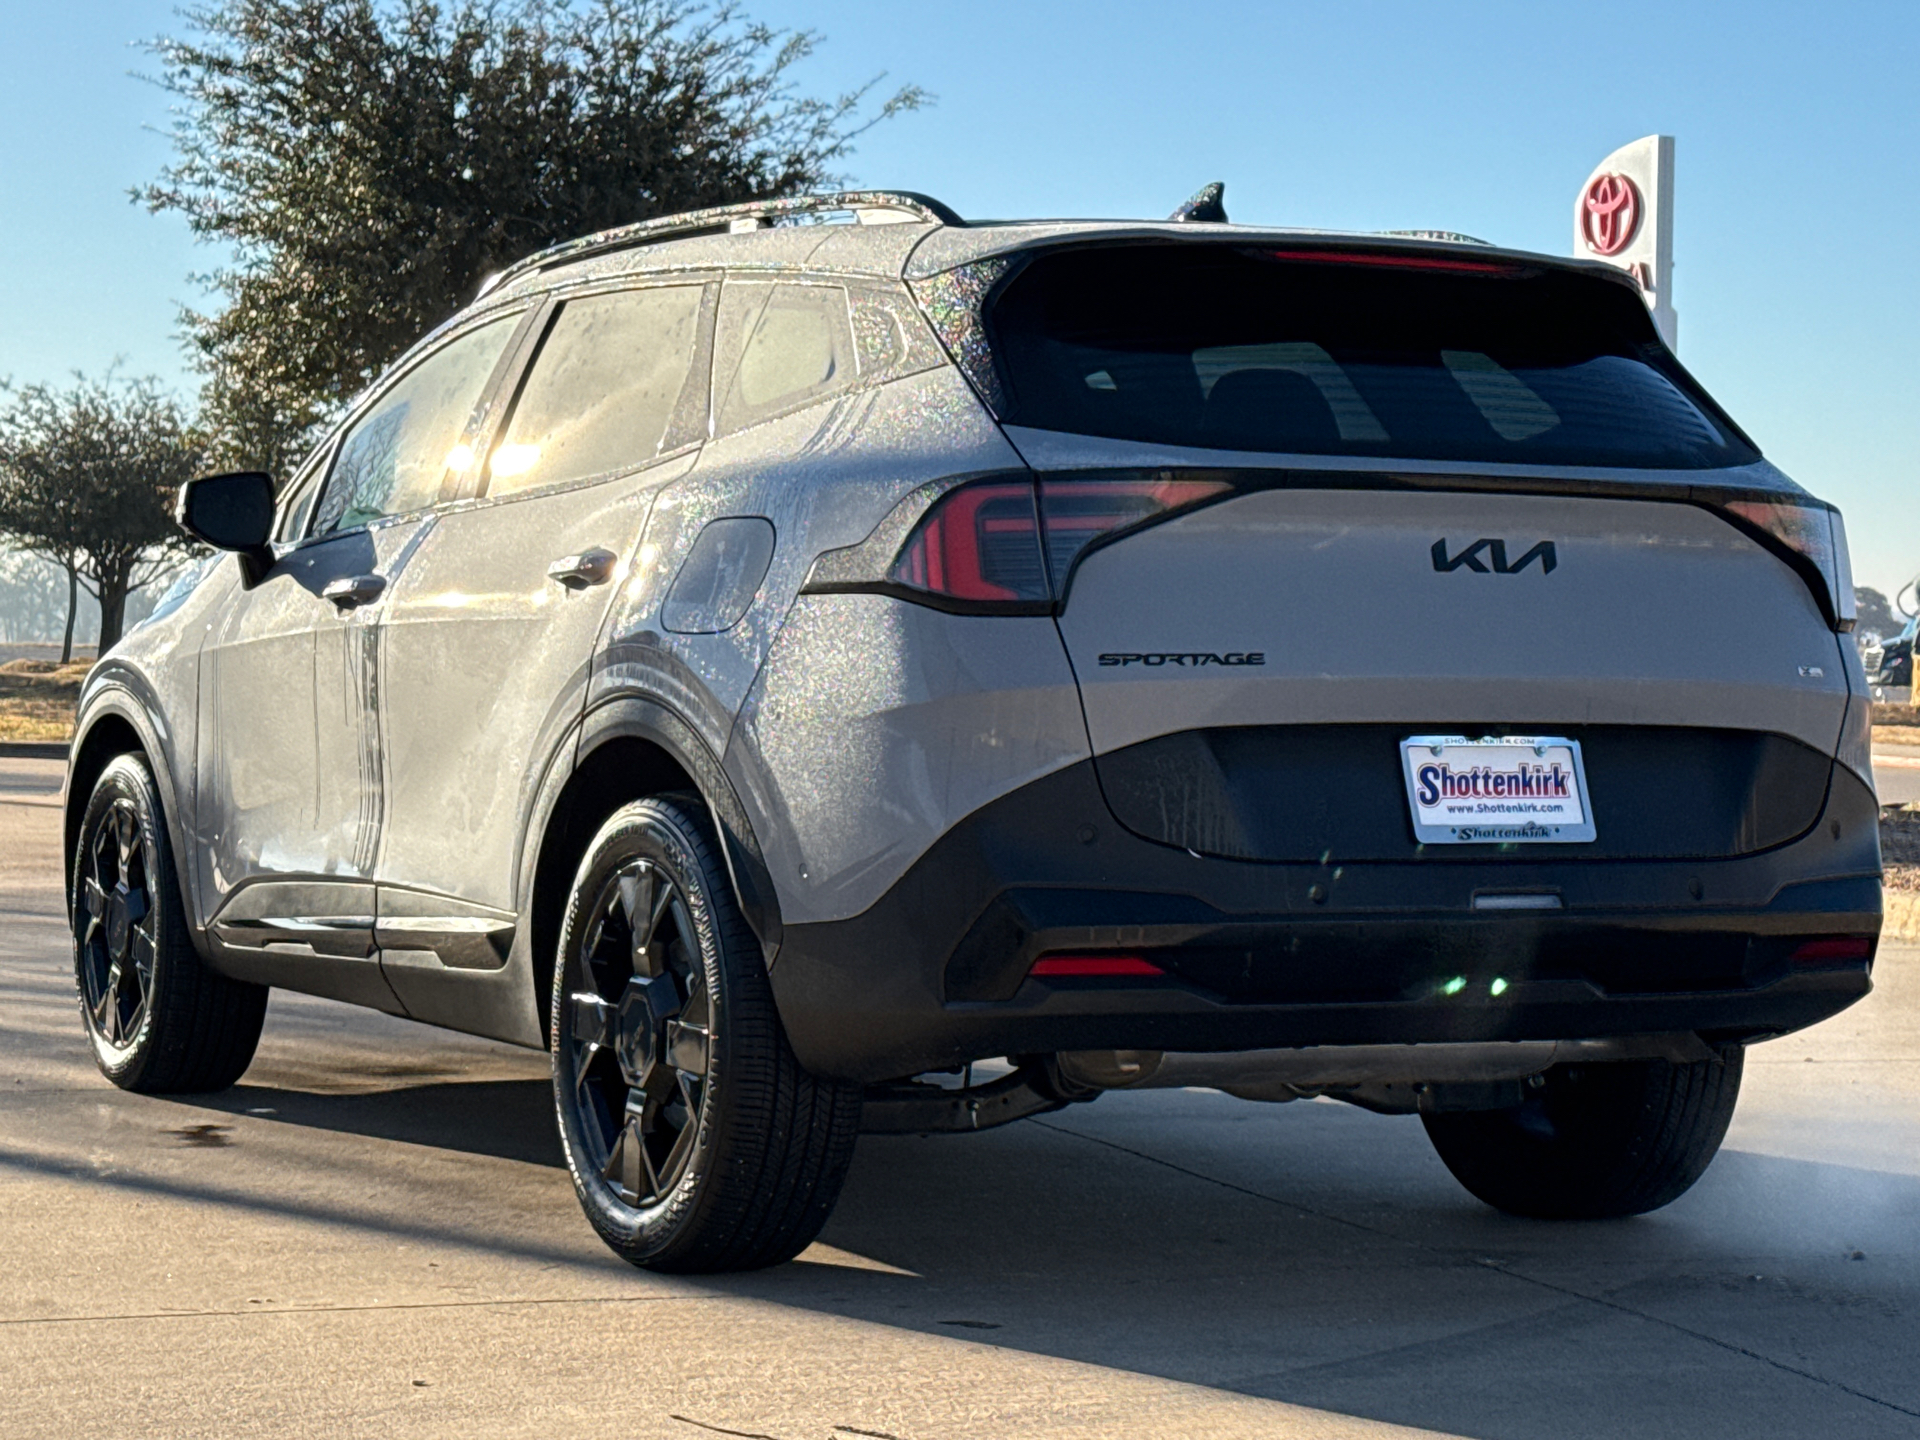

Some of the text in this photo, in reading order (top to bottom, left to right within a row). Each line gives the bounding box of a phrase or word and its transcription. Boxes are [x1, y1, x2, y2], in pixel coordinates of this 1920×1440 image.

[1431, 537, 1557, 575] KIA
[1099, 653, 1266, 667] SPORTAGE
[1418, 764, 1570, 806] Shottenkirk
[1447, 803, 1563, 813] www.Shottenkirk.com
